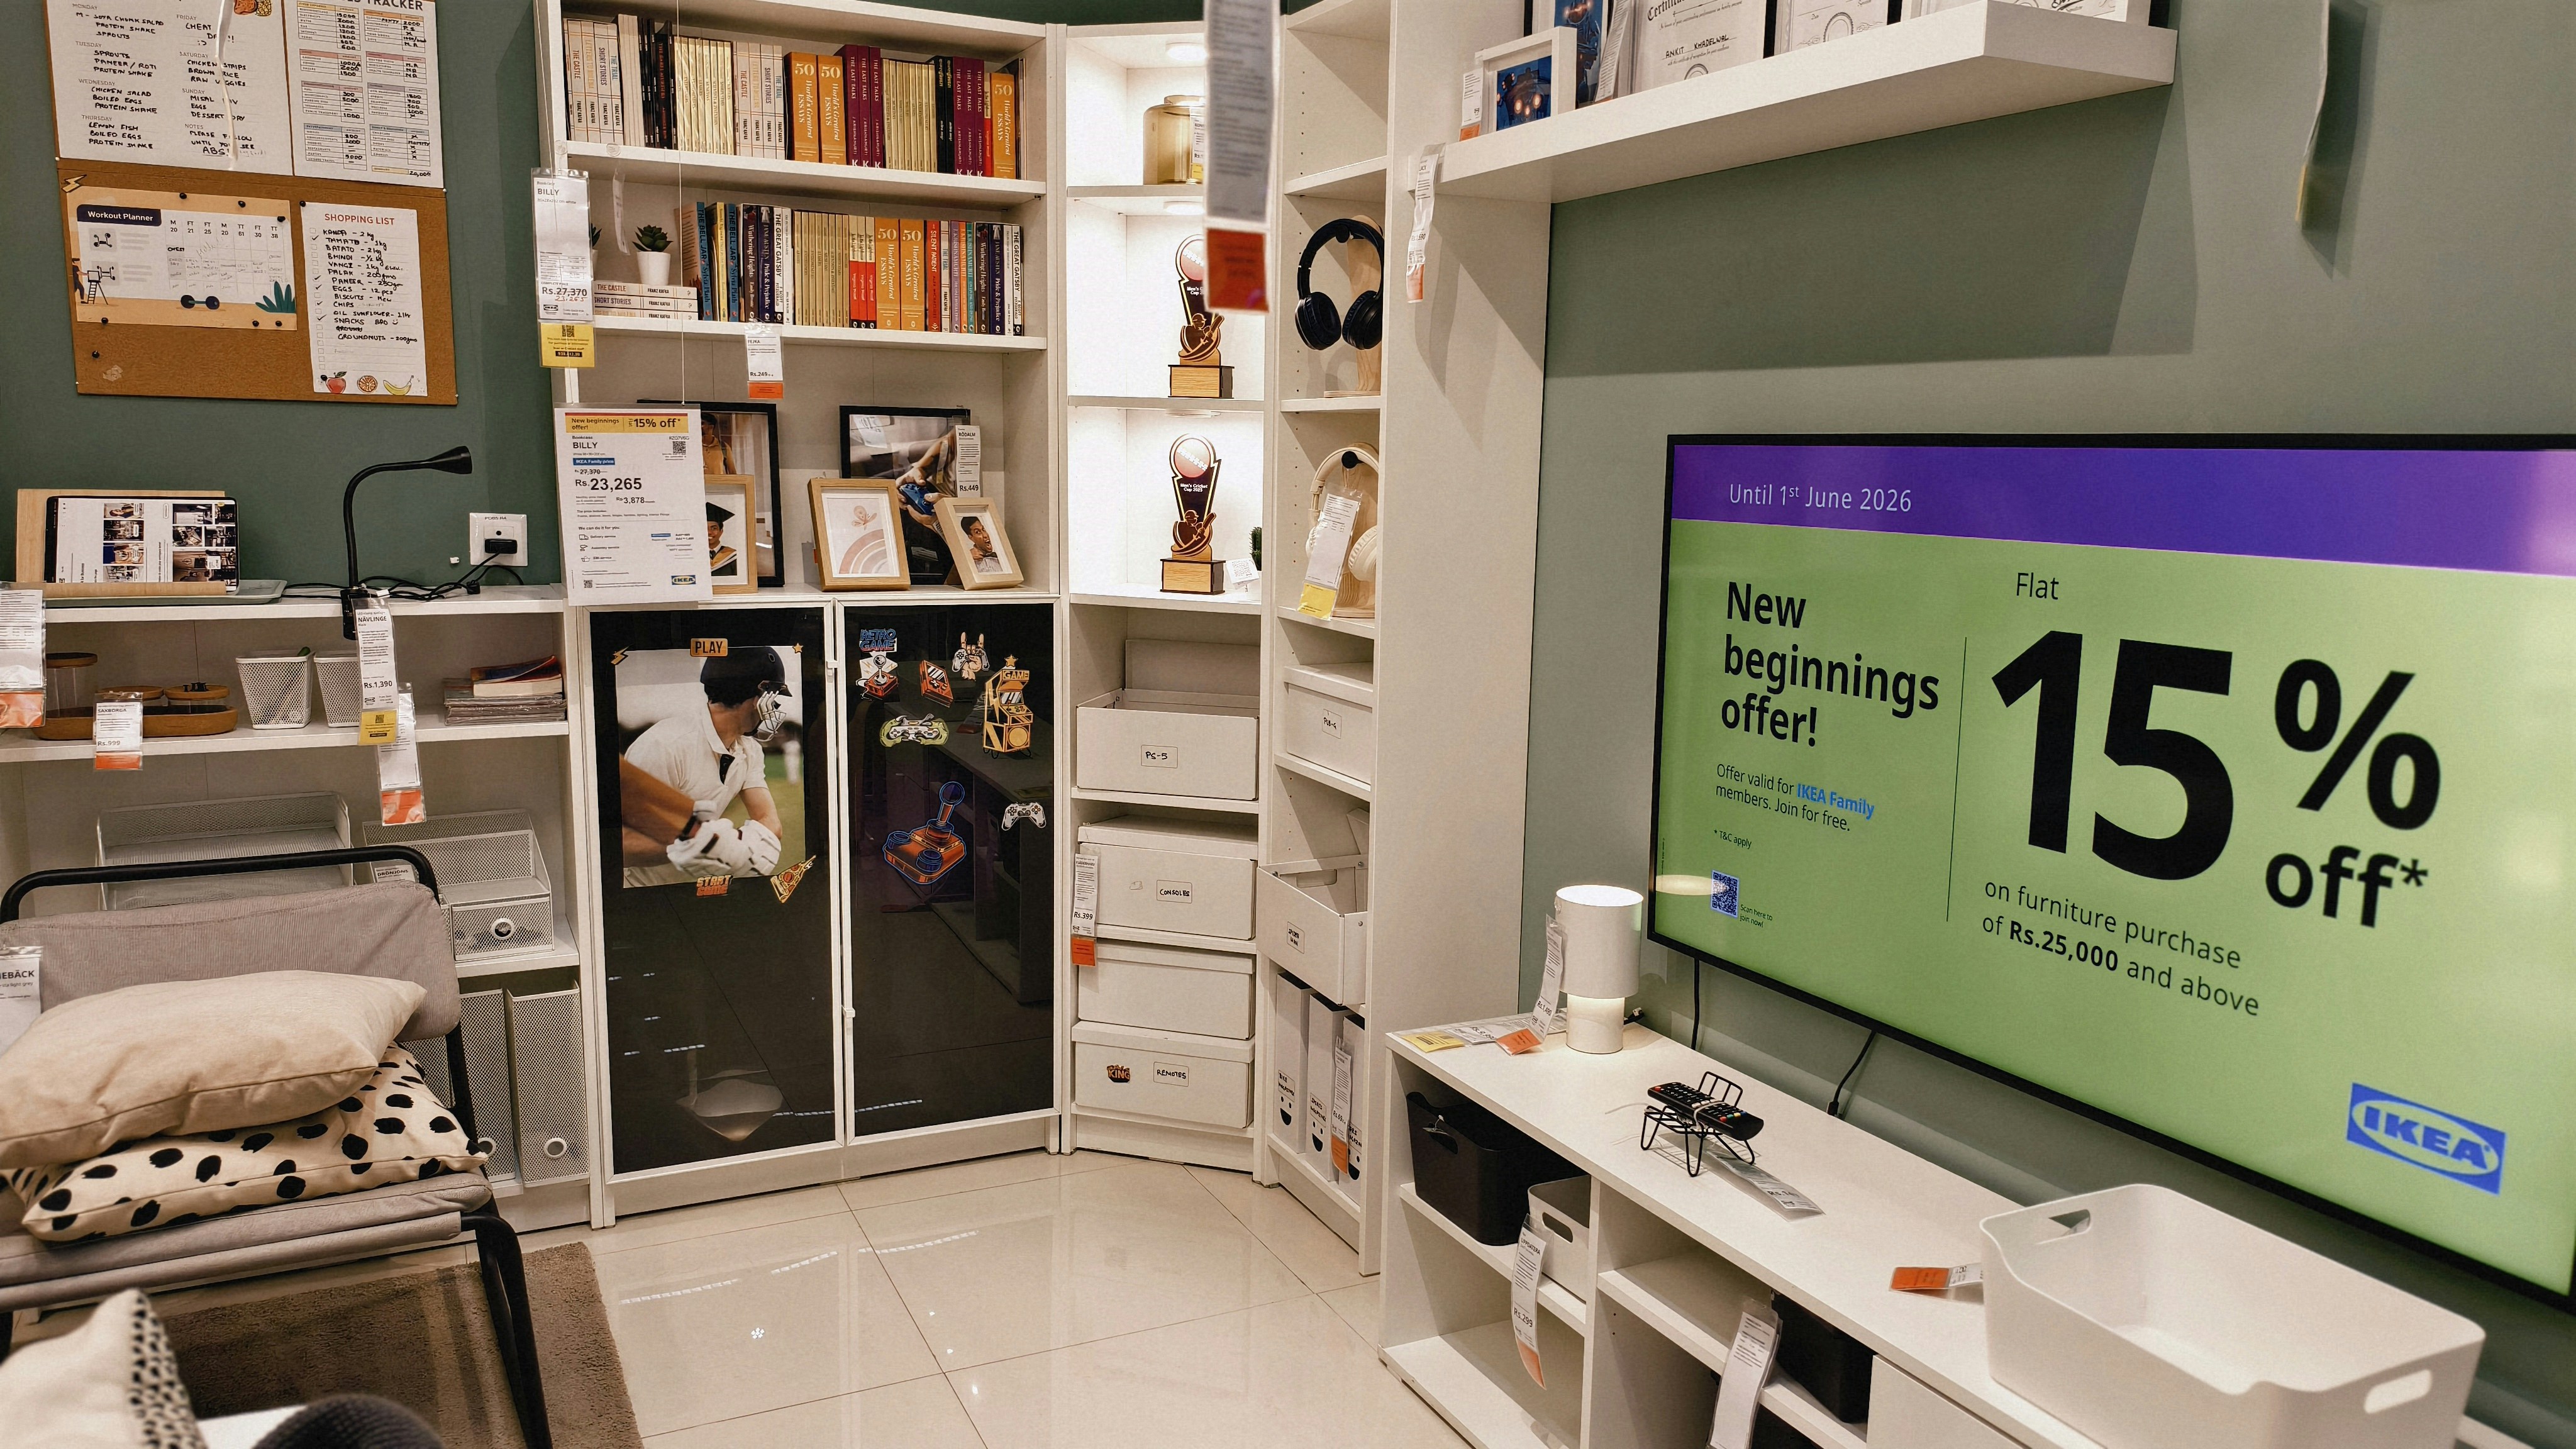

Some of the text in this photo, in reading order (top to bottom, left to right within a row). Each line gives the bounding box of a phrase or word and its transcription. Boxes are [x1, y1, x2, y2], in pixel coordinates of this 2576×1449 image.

[368, 0, 423, 11] TRACKER
[186, 22, 211, 31] CHEAT
[96, 31, 130, 40] SPROUTS
[94, 50, 130, 59] SPROUTS
[1665, 47, 1684, 58] ANKIT
[795, 64, 814, 75] 50
[821, 66, 840, 78] 50
[92, 86, 122, 94] CHICKEN
[995, 84, 1013, 96] 50
[95, 103, 126, 111] PROTEIN
[87, 211, 153, 222] Workout Planner
[325, 214, 374, 224] SHOPPING
[878, 228, 897, 240] 50
[902, 230, 921, 242] 50
[332, 277, 364, 286] PANEER
[634, 418, 657, 428] 15%
[590, 478, 642, 492] 23,265
[1730, 484, 1912, 513] Until 1st June 2026
[2016, 572, 2059, 601] Flat
[1727, 581, 1807, 628] New
[860, 628, 896, 640] RETRO
[695, 641, 723, 653] PLAY
[860, 640, 895, 653] GAME
[1004, 670, 1029, 679] GAME
[1724, 633, 1940, 719] beginnings
[364, 681, 392, 689] Rs.1,390
[1721, 692, 1818, 747] offer!
[1146, 752, 1168, 760] PS-5
[1991, 630, 2234, 880] 15
[1717, 763, 1875, 821] Offer valid for IKEA Family
[1716, 784, 1851, 831] members. Join for free.
[1719, 830, 1752, 850] T&C apply
[697, 875, 731, 887] START
[1160, 889, 1190, 897] CONSOLES
[1074, 911, 1093, 920] Rs.399
[1740, 904, 1753, 914] Scan
[1753, 909, 1766, 919] here
[1740, 913, 1750, 923] join
[1985, 882, 2241, 969] on furniture purchase
[1983, 916, 2259, 1016] of Rs.25,000 and above
[1108, 1069, 1131, 1080] KING
[1157, 1069, 1186, 1079] REMOTES
[2363, 1105, 2488, 1170] IKEA
[1521, 1237, 1540, 1255] UPPDATERA
[1514, 1307, 1533, 1328] Rs.299
